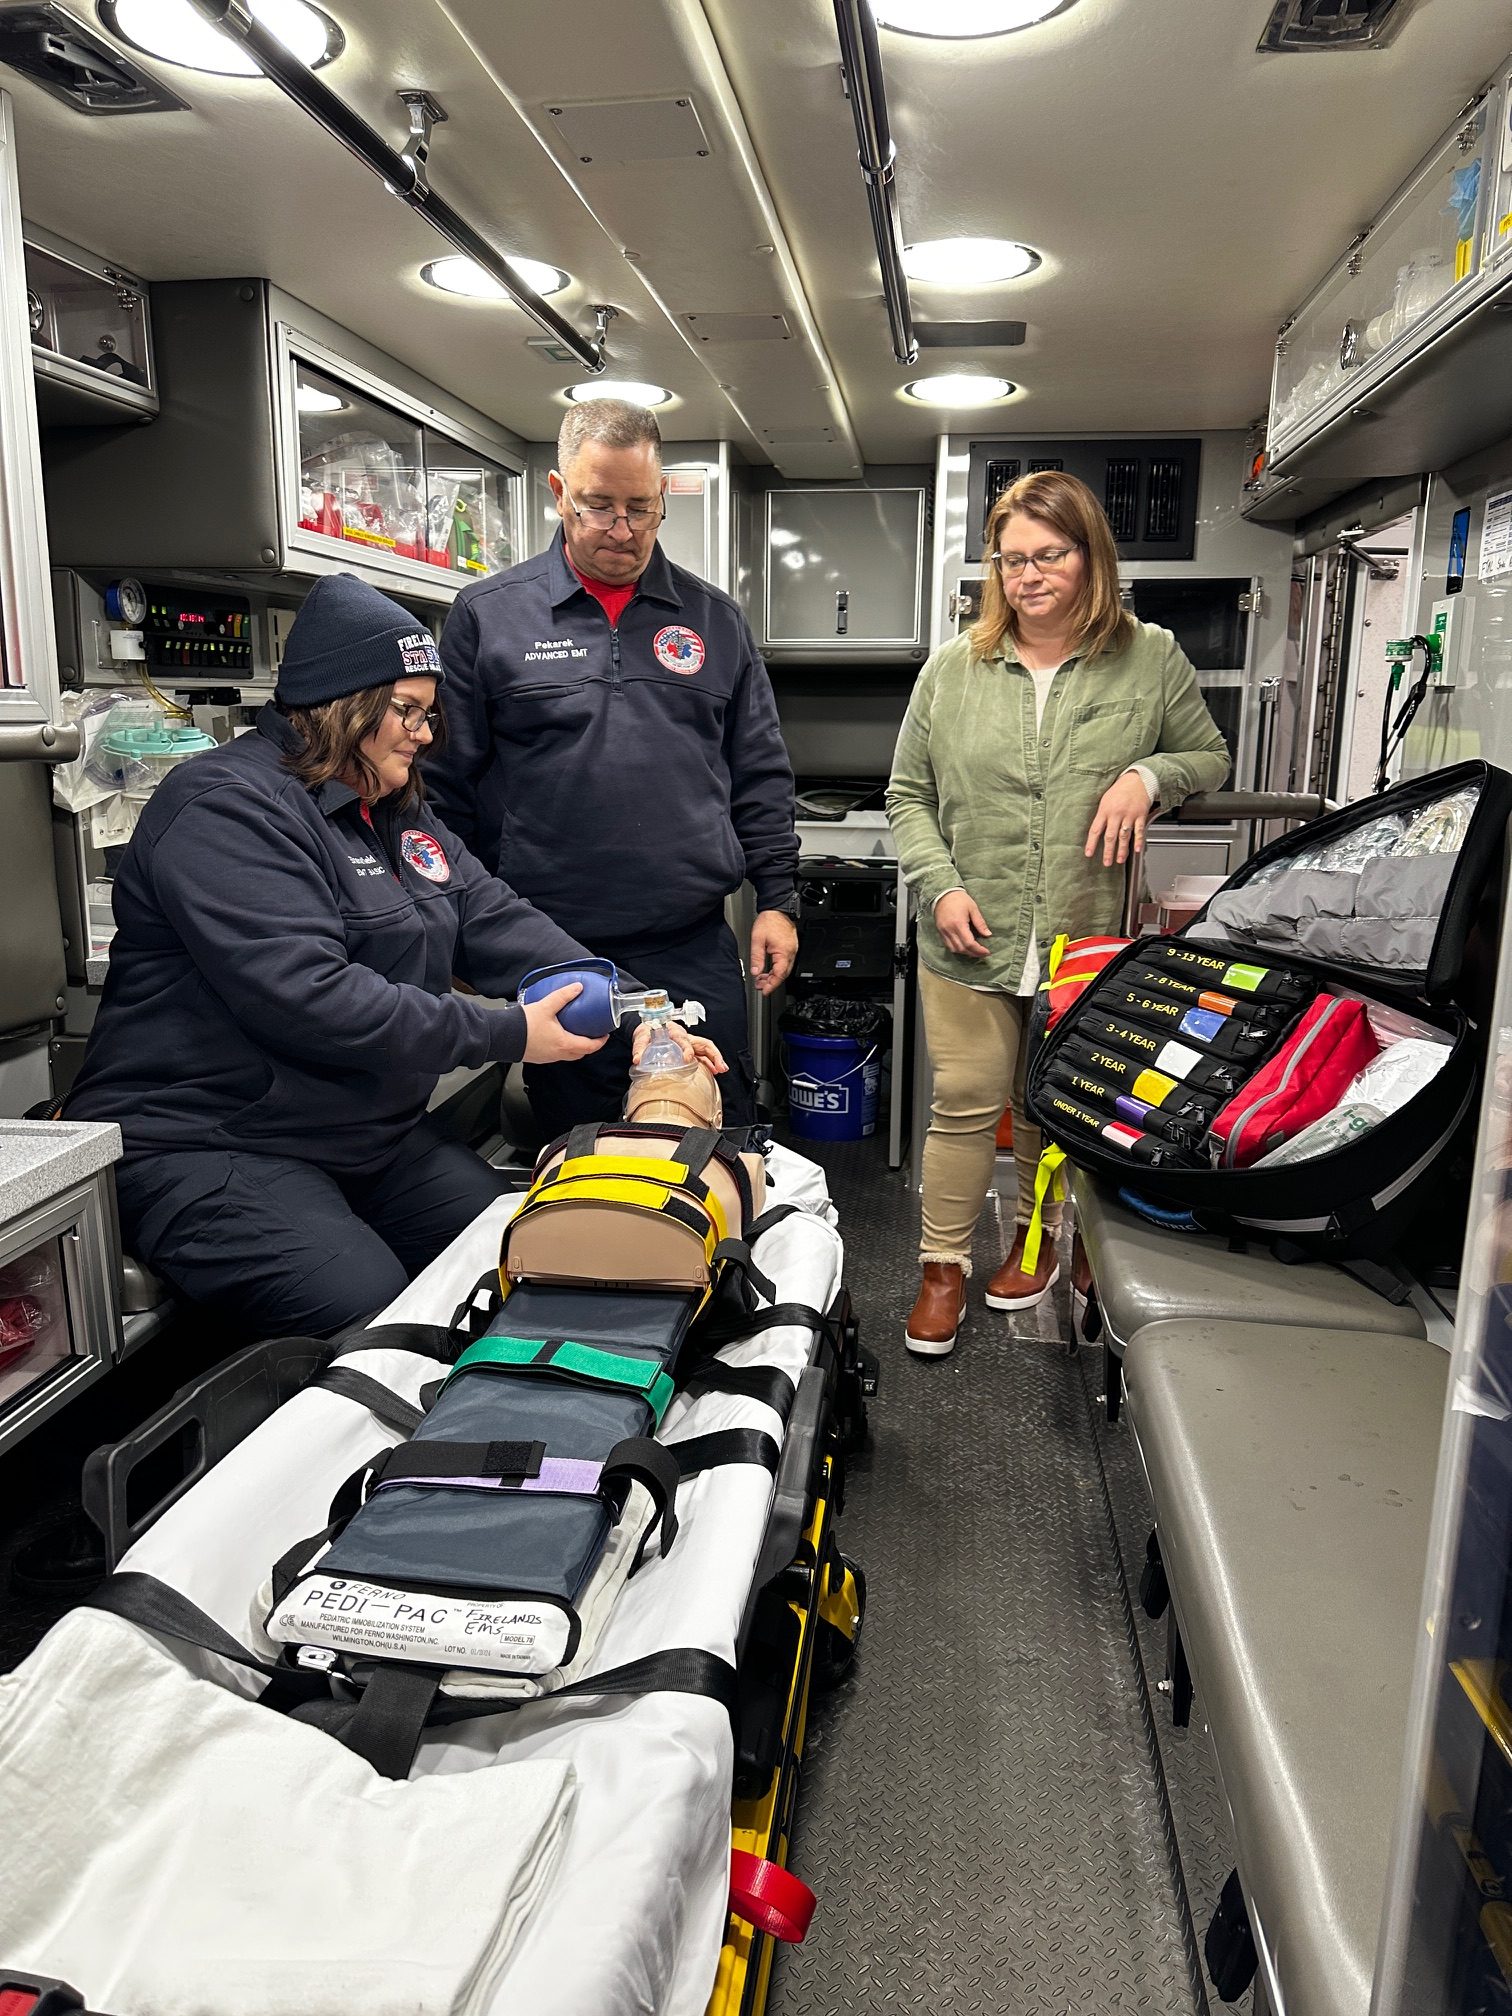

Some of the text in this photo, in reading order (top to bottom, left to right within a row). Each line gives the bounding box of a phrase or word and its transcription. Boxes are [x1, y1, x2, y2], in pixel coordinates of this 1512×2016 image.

[534, 638, 574, 649] Pekarek
[524, 648, 588, 661] ADVANCED EMT
[1196, 956, 1226, 970] YEAR
[1168, 980, 1197, 993] YEAR
[1151, 1003, 1179, 1017] YEAR
[1128, 1032, 1157, 1052] YEAR
[1090, 1052, 1127, 1074] 2 YEAR
[1071, 1076, 1105, 1097] 1 YEAR
[1053, 1098, 1100, 1128] UNDER 1 YEAR
[347, 1583, 407, 1601] FERNO
[319, 1612, 426, 1634] PEDIATRIC IMMOBILIZATION SYSTEM
[466, 1608, 543, 1625] FIRELANDS
[300, 1620, 350, 1634] MANUFACTURED
[350, 1627, 364, 1636] FOR
[364, 1629, 386, 1640] FERNO
[464, 1621, 505, 1636] EMS
[504, 1635, 525, 1643] MODEL
[444, 1645, 457, 1653] LOT
